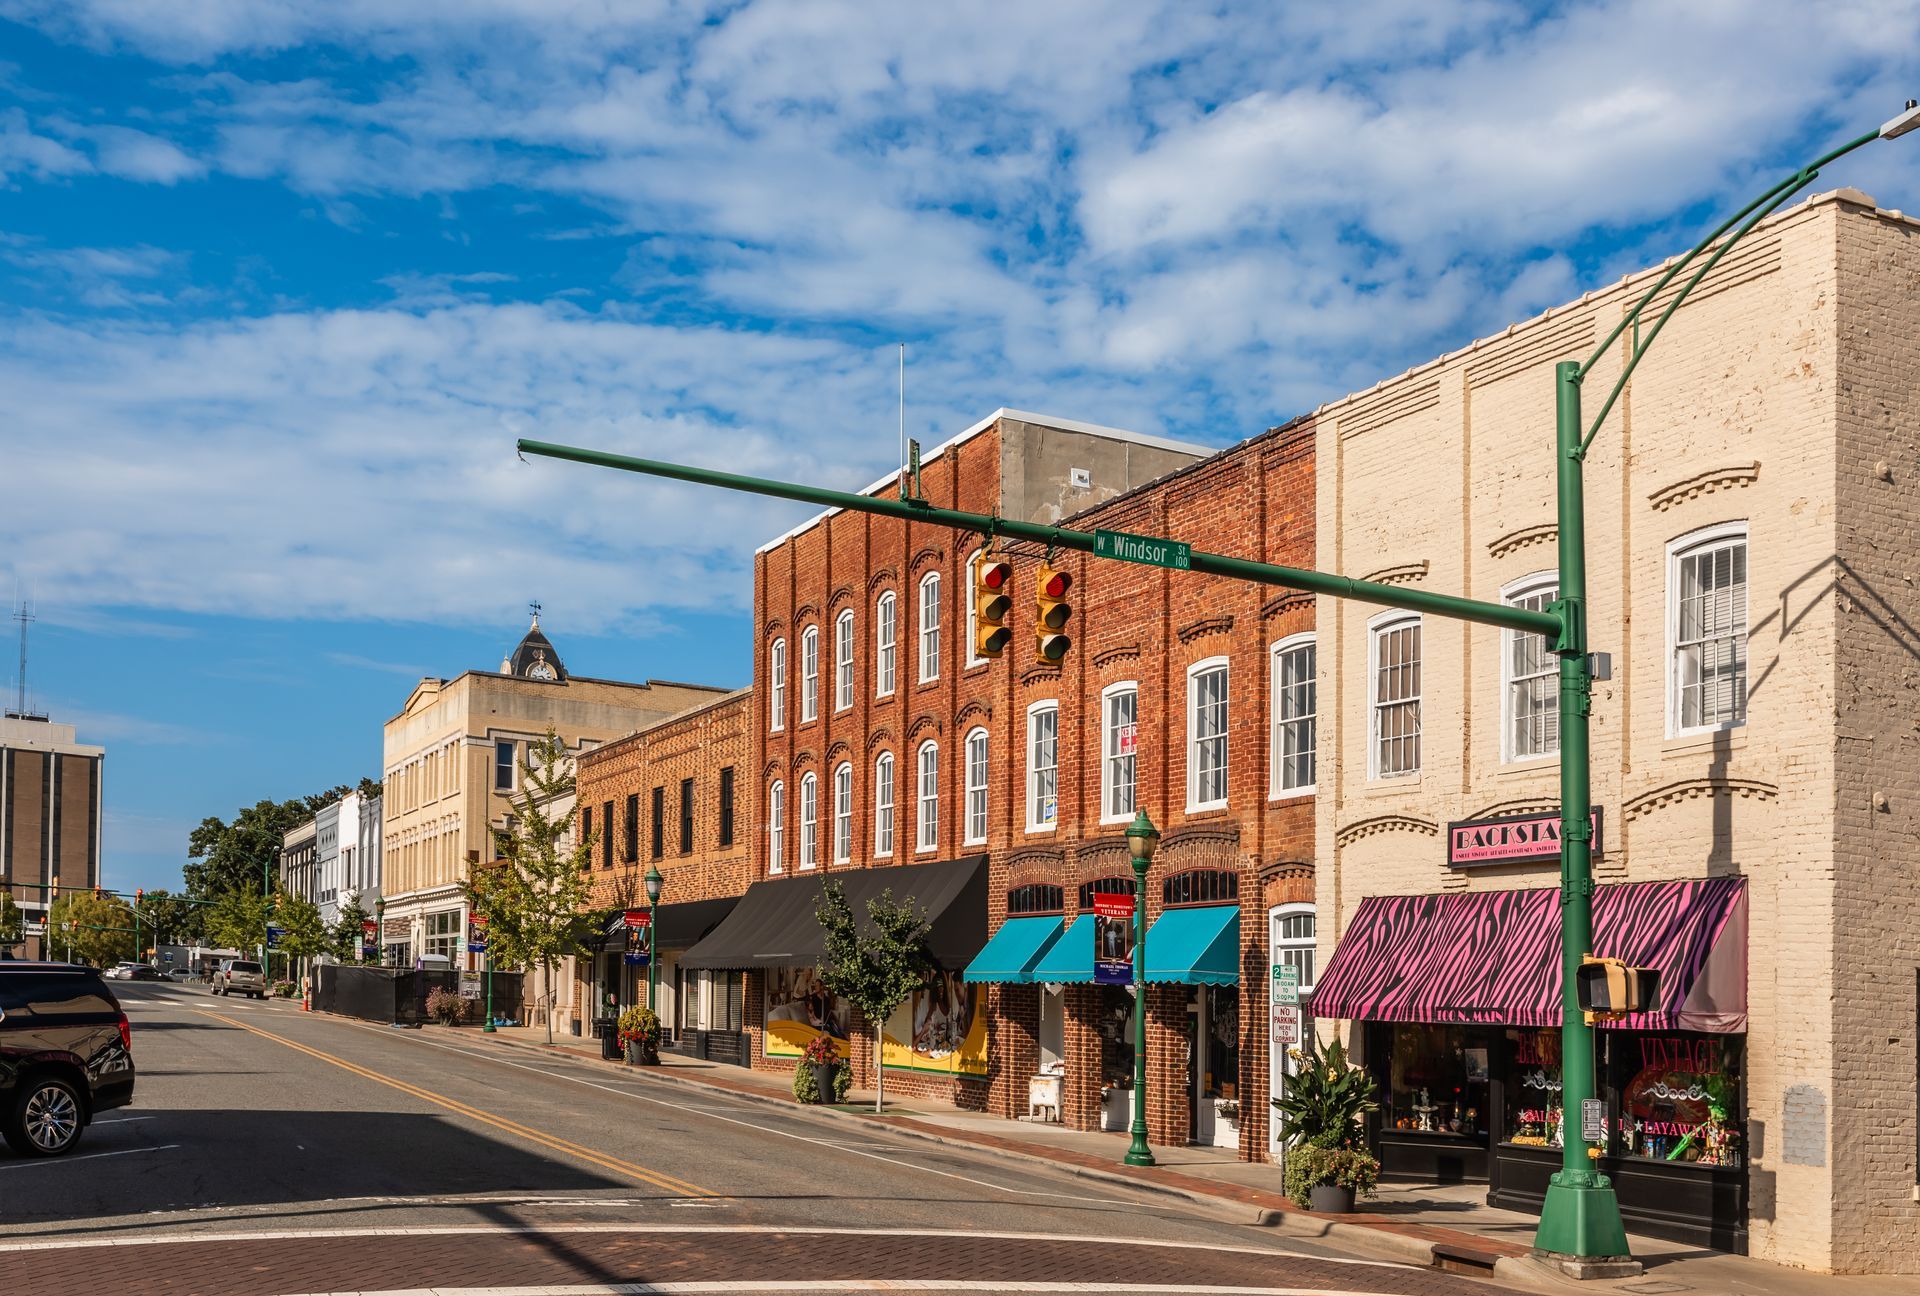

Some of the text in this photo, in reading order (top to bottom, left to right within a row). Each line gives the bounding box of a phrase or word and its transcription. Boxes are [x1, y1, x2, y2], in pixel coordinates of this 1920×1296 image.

[1097, 536, 1186, 563] W Windsor St
[1175, 556, 1188, 567] 100
[1456, 820, 1562, 849] BACKSTA
[1274, 967, 1280, 977] 2
[1280, 1008, 1290, 1016] NO
[1437, 1010, 1455, 1021] 100
[1472, 1010, 1503, 1023] MAIN
[1274, 1016, 1296, 1024] PARKING
[1639, 1037, 1720, 1074] VINTAGE
[1643, 1120, 1707, 1139] LAYAWAY
